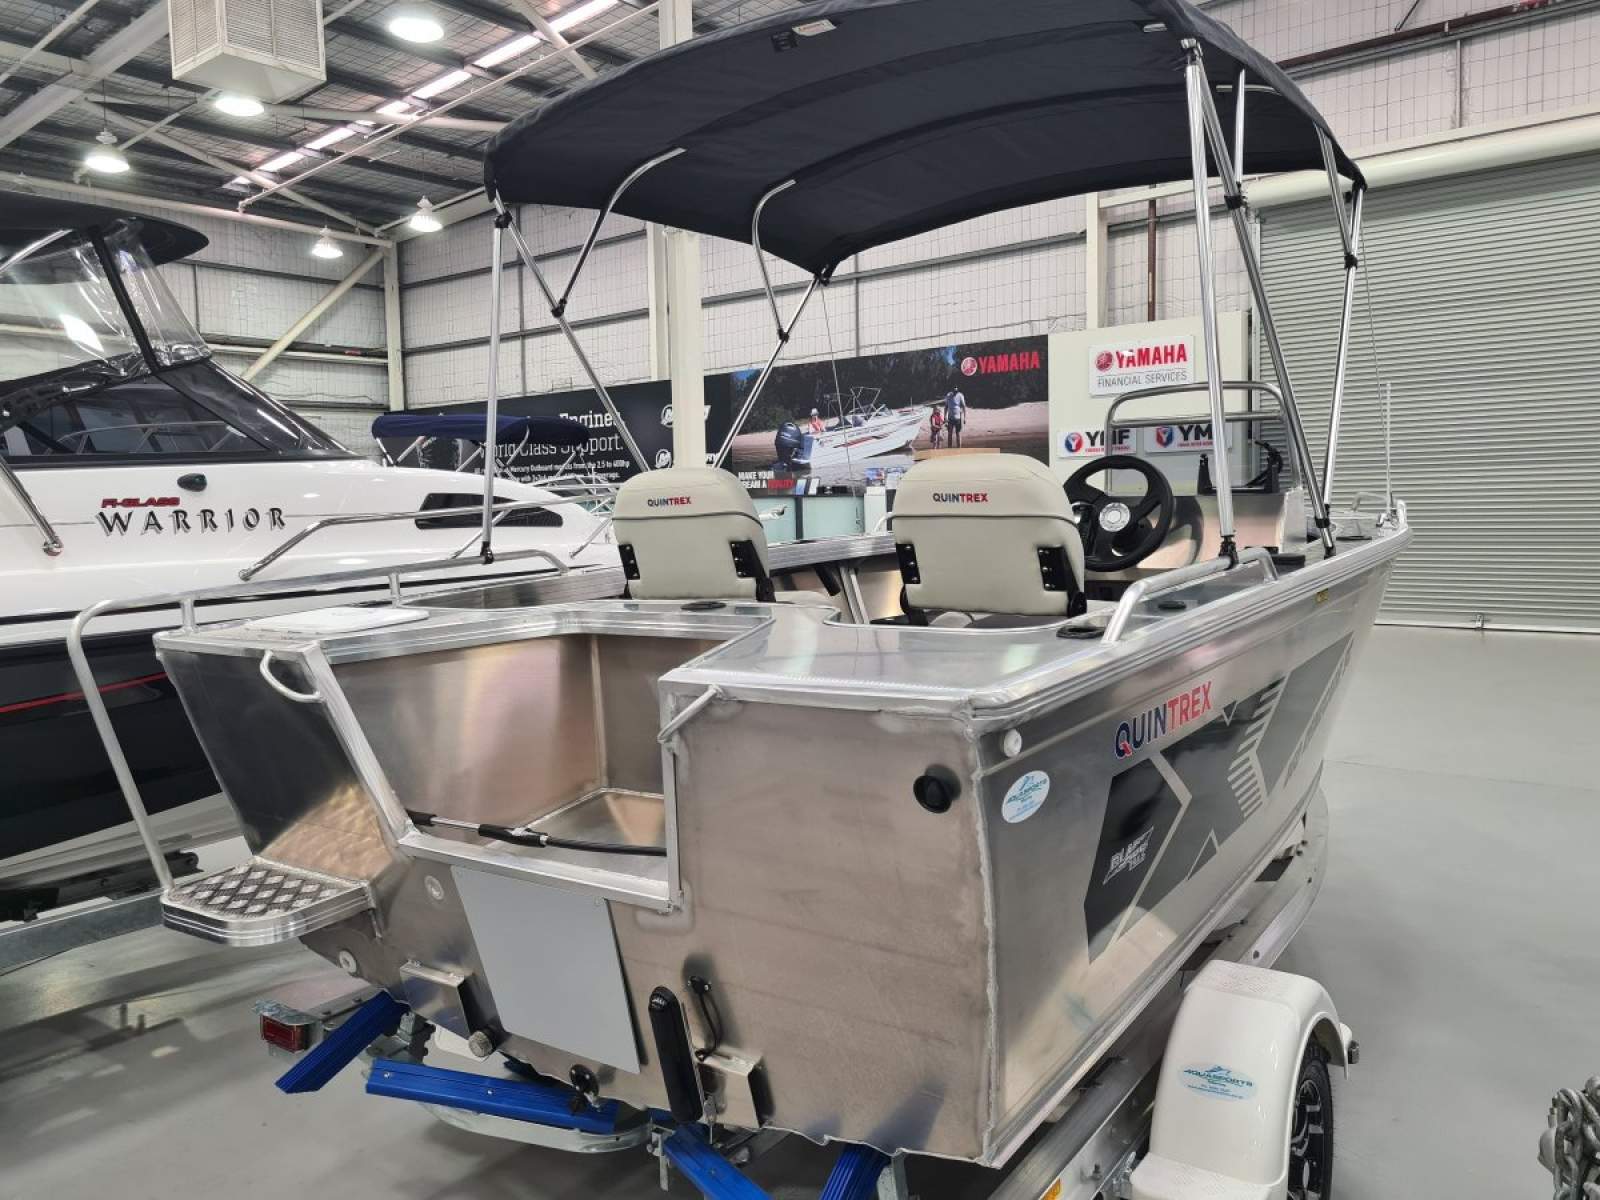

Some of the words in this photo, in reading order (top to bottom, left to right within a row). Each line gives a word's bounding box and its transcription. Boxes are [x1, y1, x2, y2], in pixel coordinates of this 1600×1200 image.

[978, 351, 1041, 374] YAMAHA
[1115, 343, 1188, 369] YAMAHA
[1097, 374, 1142, 388] FINANCIAL
[1144, 370, 1188, 385] SERVICES
[1178, 423, 1214, 441] YM
[647, 495, 692, 507] QUINTREX
[932, 491, 989, 504] QUINTREX
[95, 506, 287, 537] WARRIOR
[1114, 681, 1212, 760] QUINTREX
